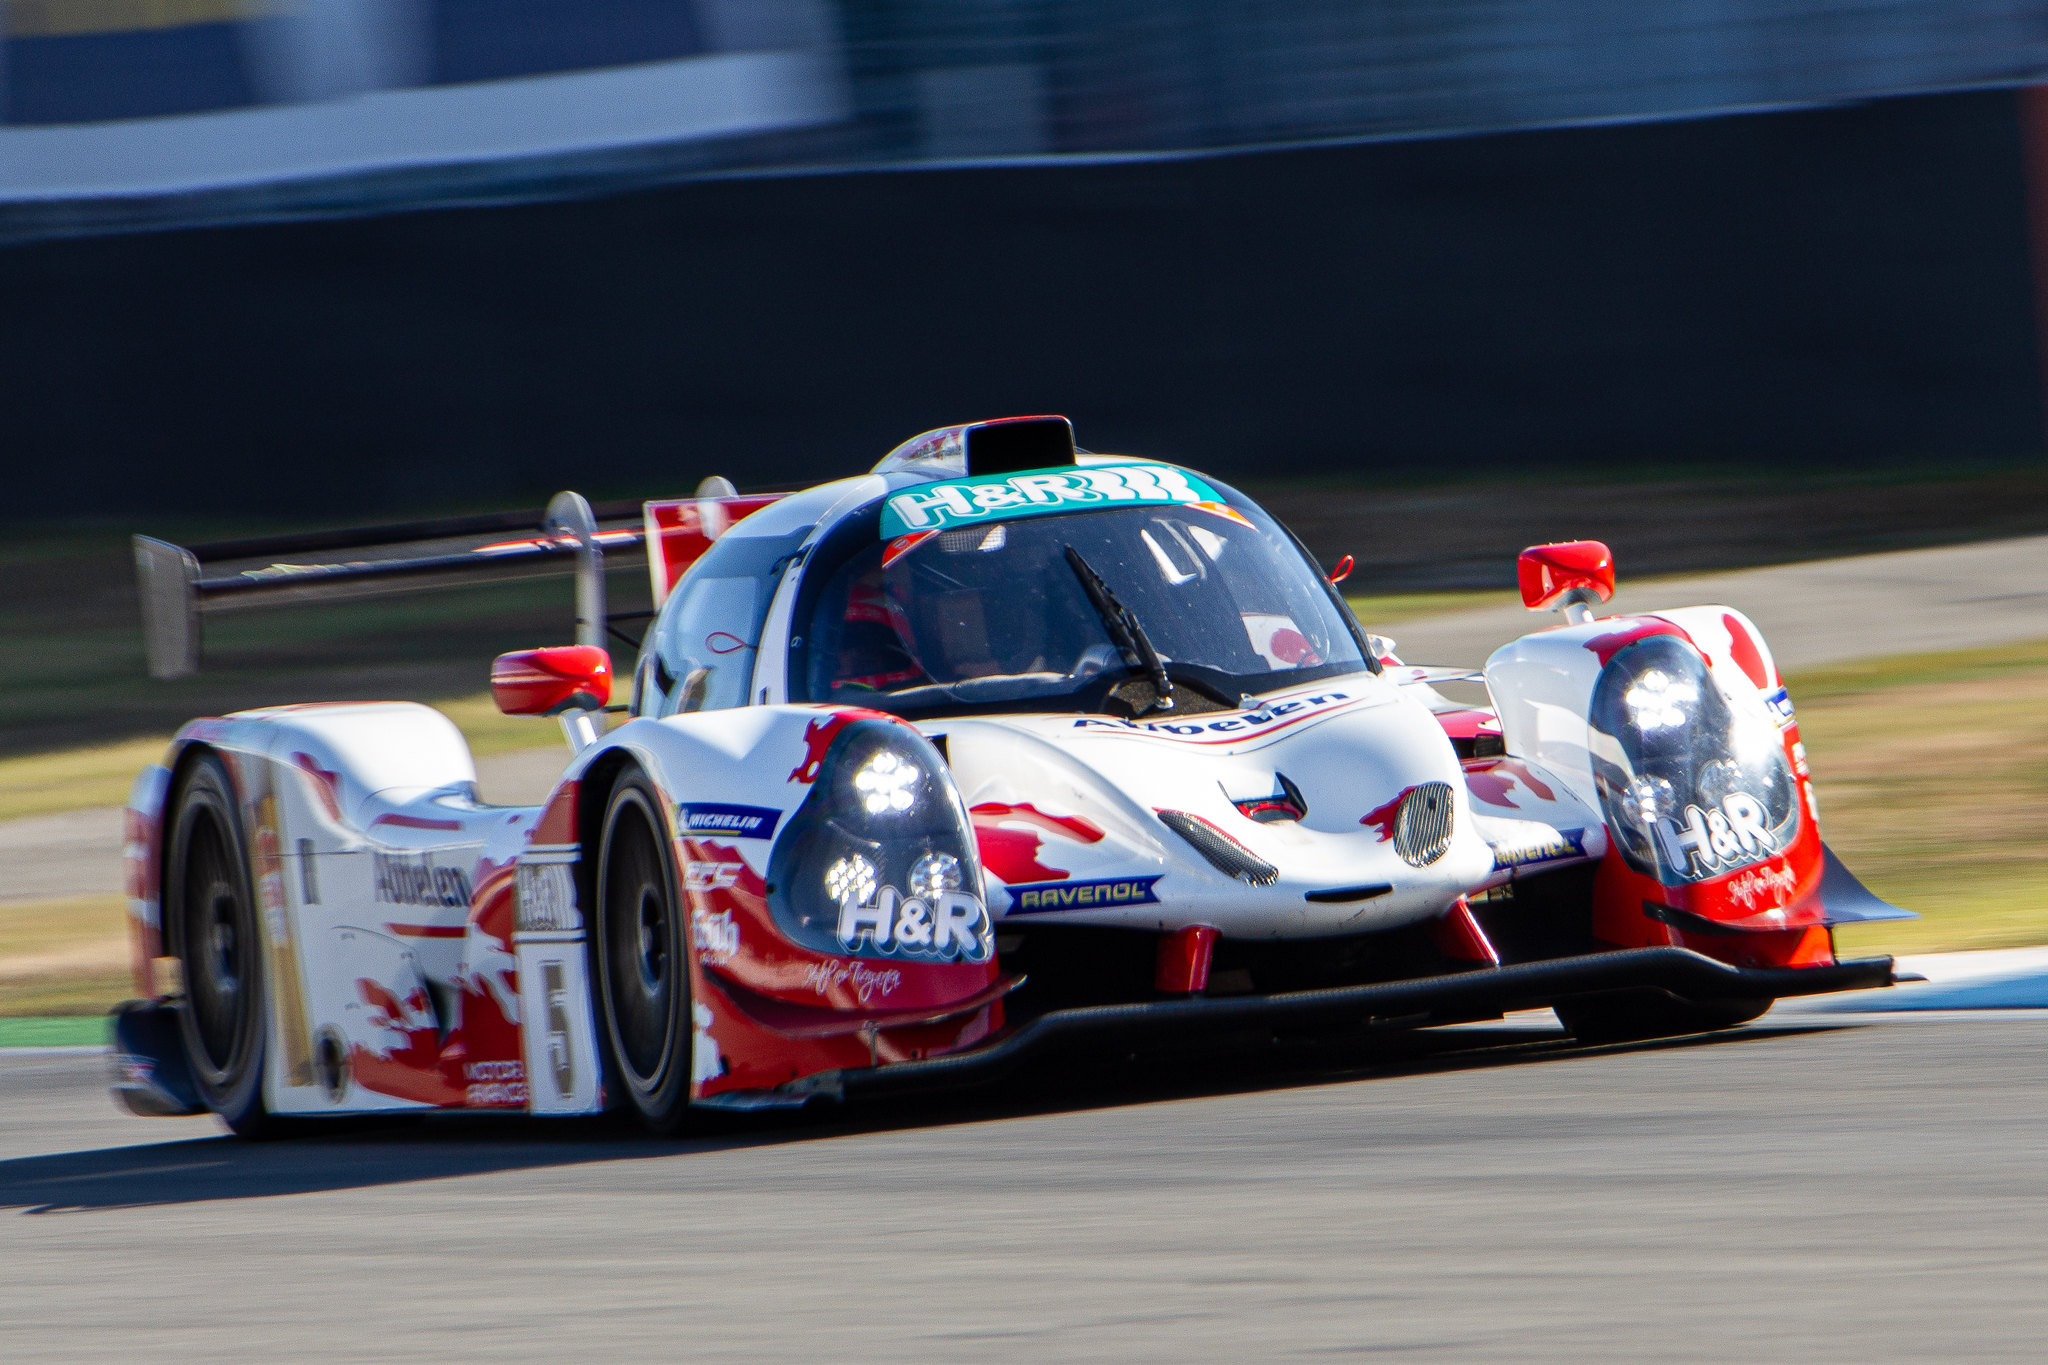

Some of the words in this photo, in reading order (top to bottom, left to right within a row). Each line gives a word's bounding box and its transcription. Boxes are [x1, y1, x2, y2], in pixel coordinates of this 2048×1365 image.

[890, 474, 1092, 528] H&R
[688, 812, 764, 830] MICHELIN
[1656, 793, 1777, 874] H&R
[839, 886, 980, 951] H&R
[1021, 882, 1145, 909] RAVENOL
